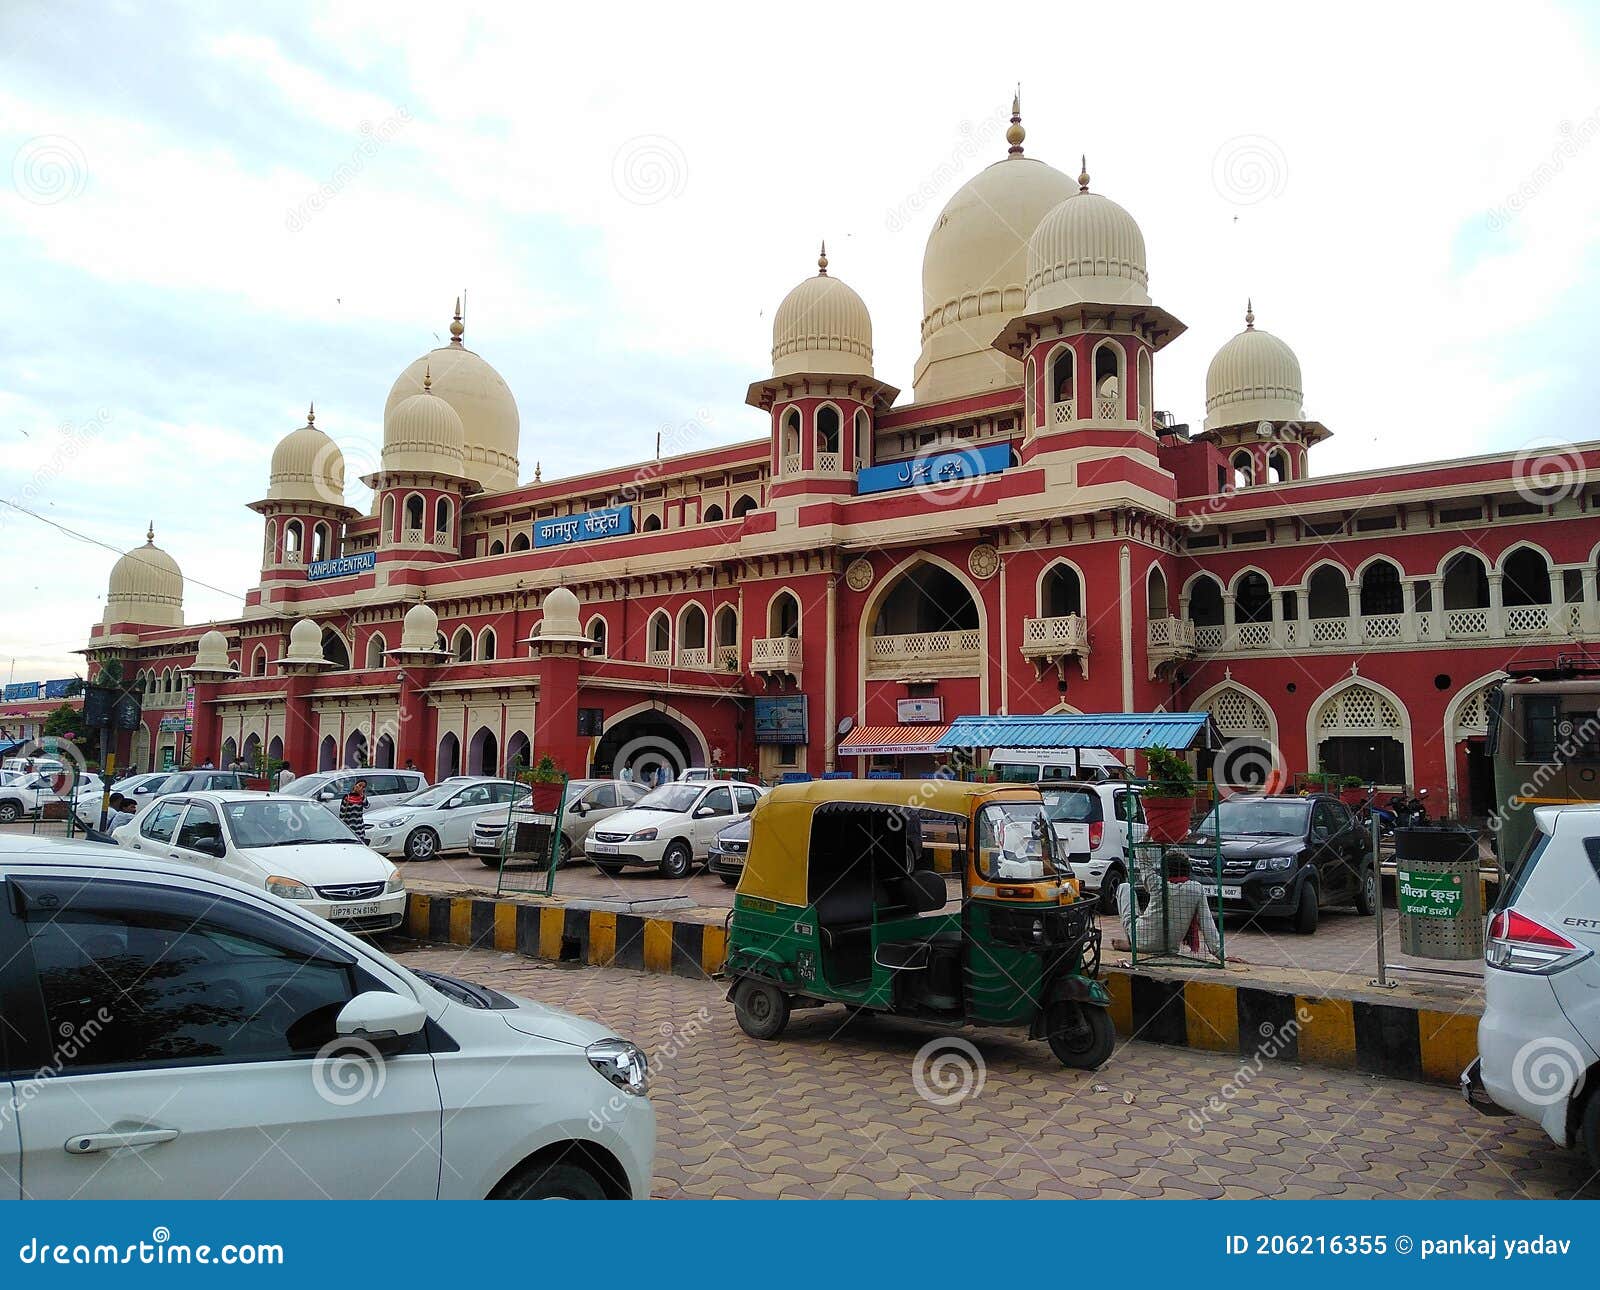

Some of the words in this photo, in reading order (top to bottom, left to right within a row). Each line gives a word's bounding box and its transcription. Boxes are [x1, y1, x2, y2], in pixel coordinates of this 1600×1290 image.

[541, 520, 578, 541] कानपुर
[308, 561, 337, 577] KANPUR
[338, 555, 372, 572] CENTRAL
[1401, 883, 1428, 898] गीला
[1430, 889, 1461, 904] कूड़ा
[1407, 905, 1428, 914] इसमें
